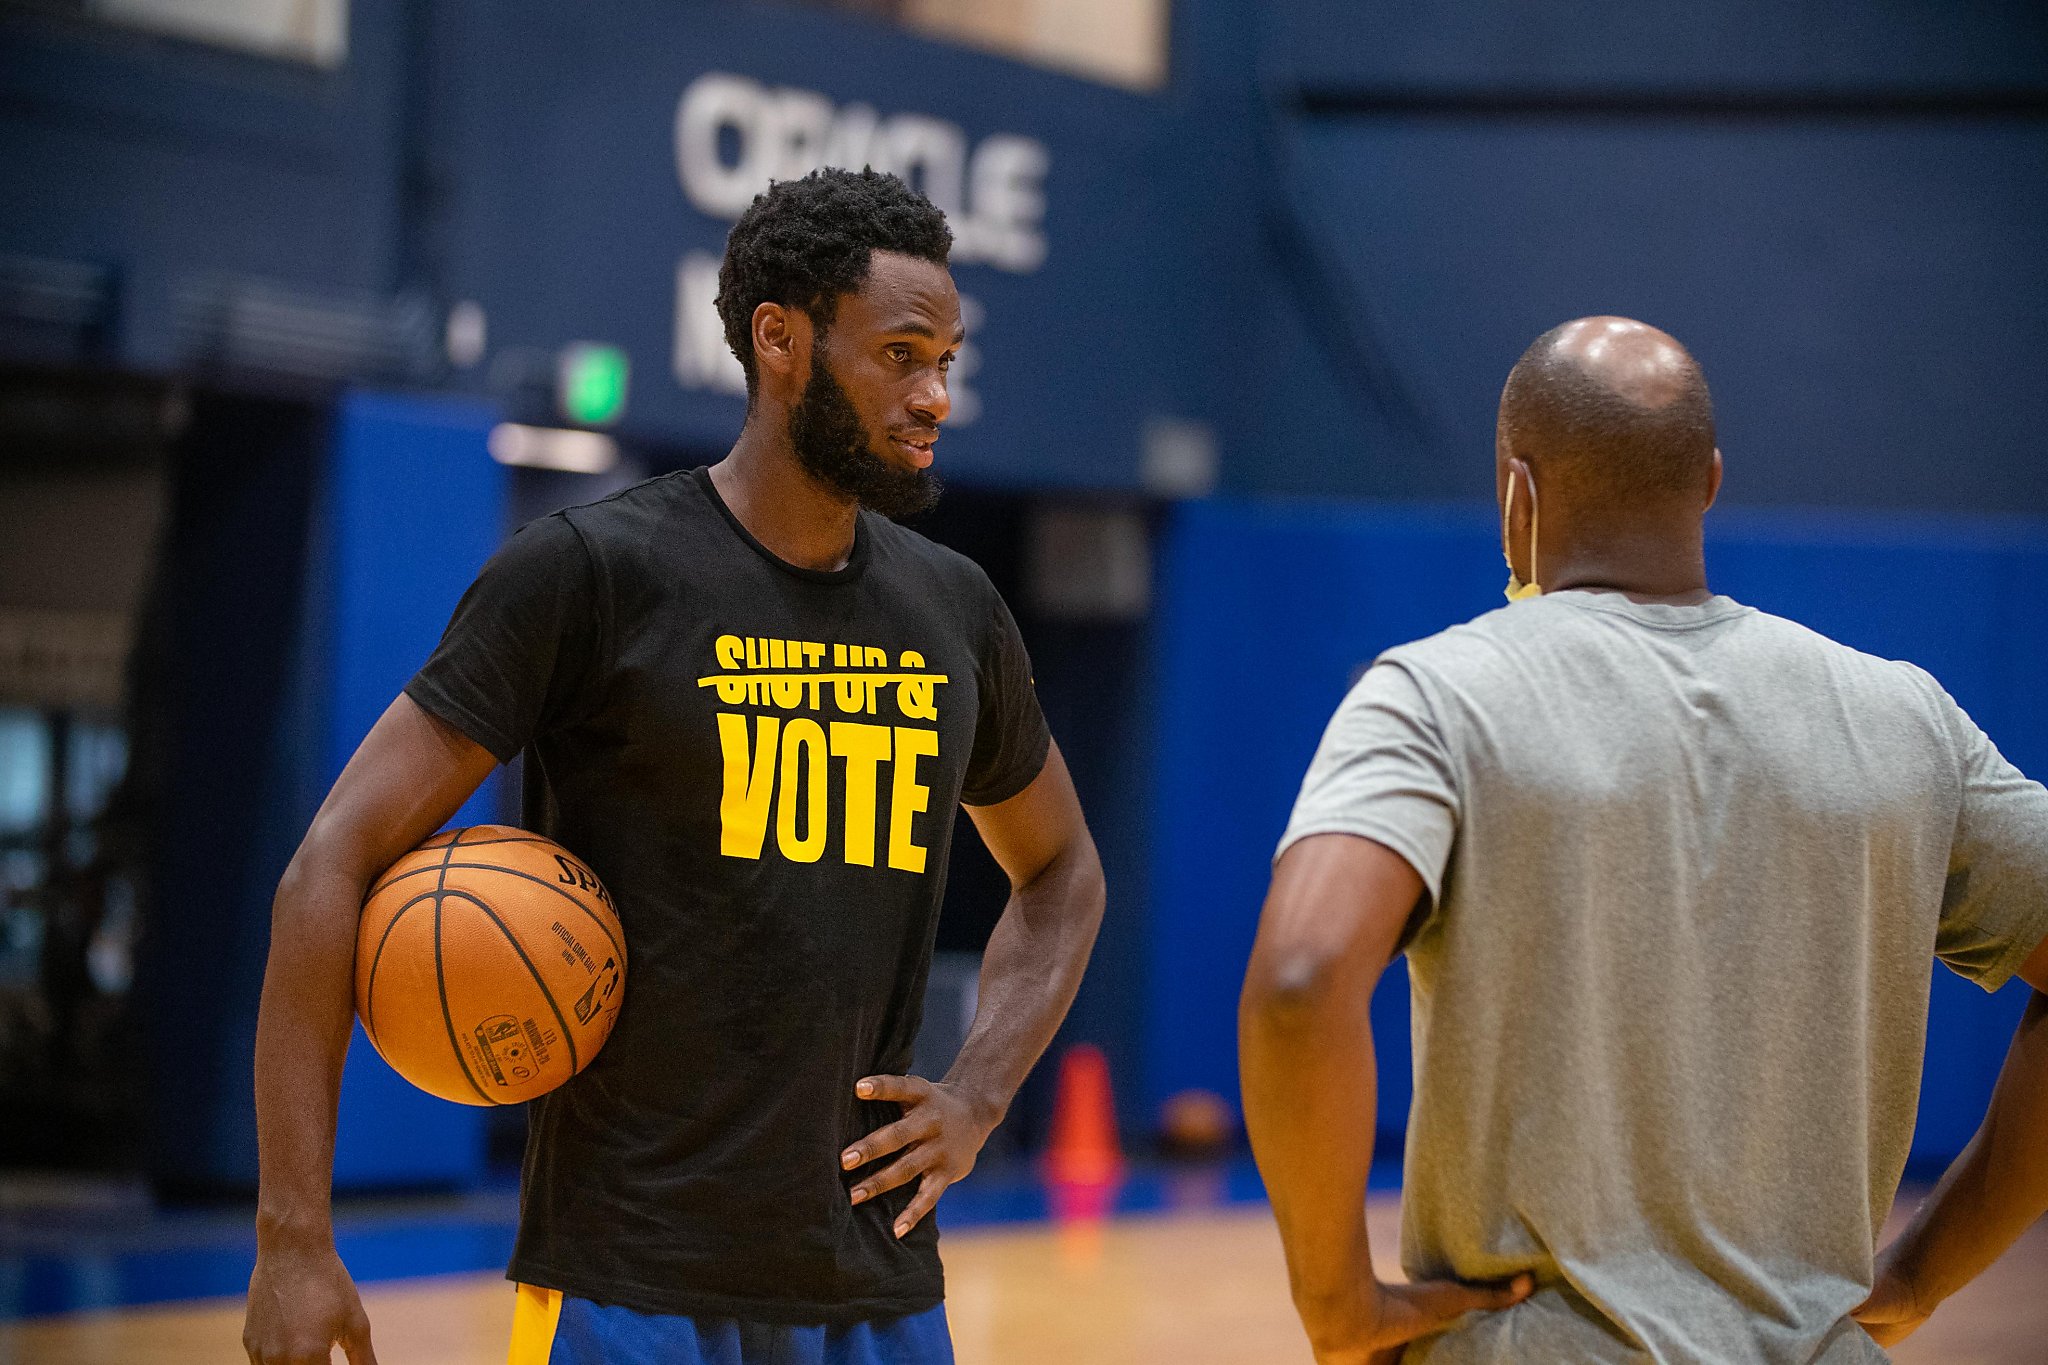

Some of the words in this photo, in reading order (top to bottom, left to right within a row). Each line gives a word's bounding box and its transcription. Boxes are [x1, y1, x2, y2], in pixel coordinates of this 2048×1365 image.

[715, 634, 826, 711] SHUT
[833, 643, 888, 715] UP
[896, 650, 938, 722] &
[716, 712, 939, 874] VOTE
[554, 854, 619, 919] SPA
[551, 921, 576, 949] OFFICIAL
[573, 942, 588, 964] GAME
[583, 956, 597, 976] BALL
